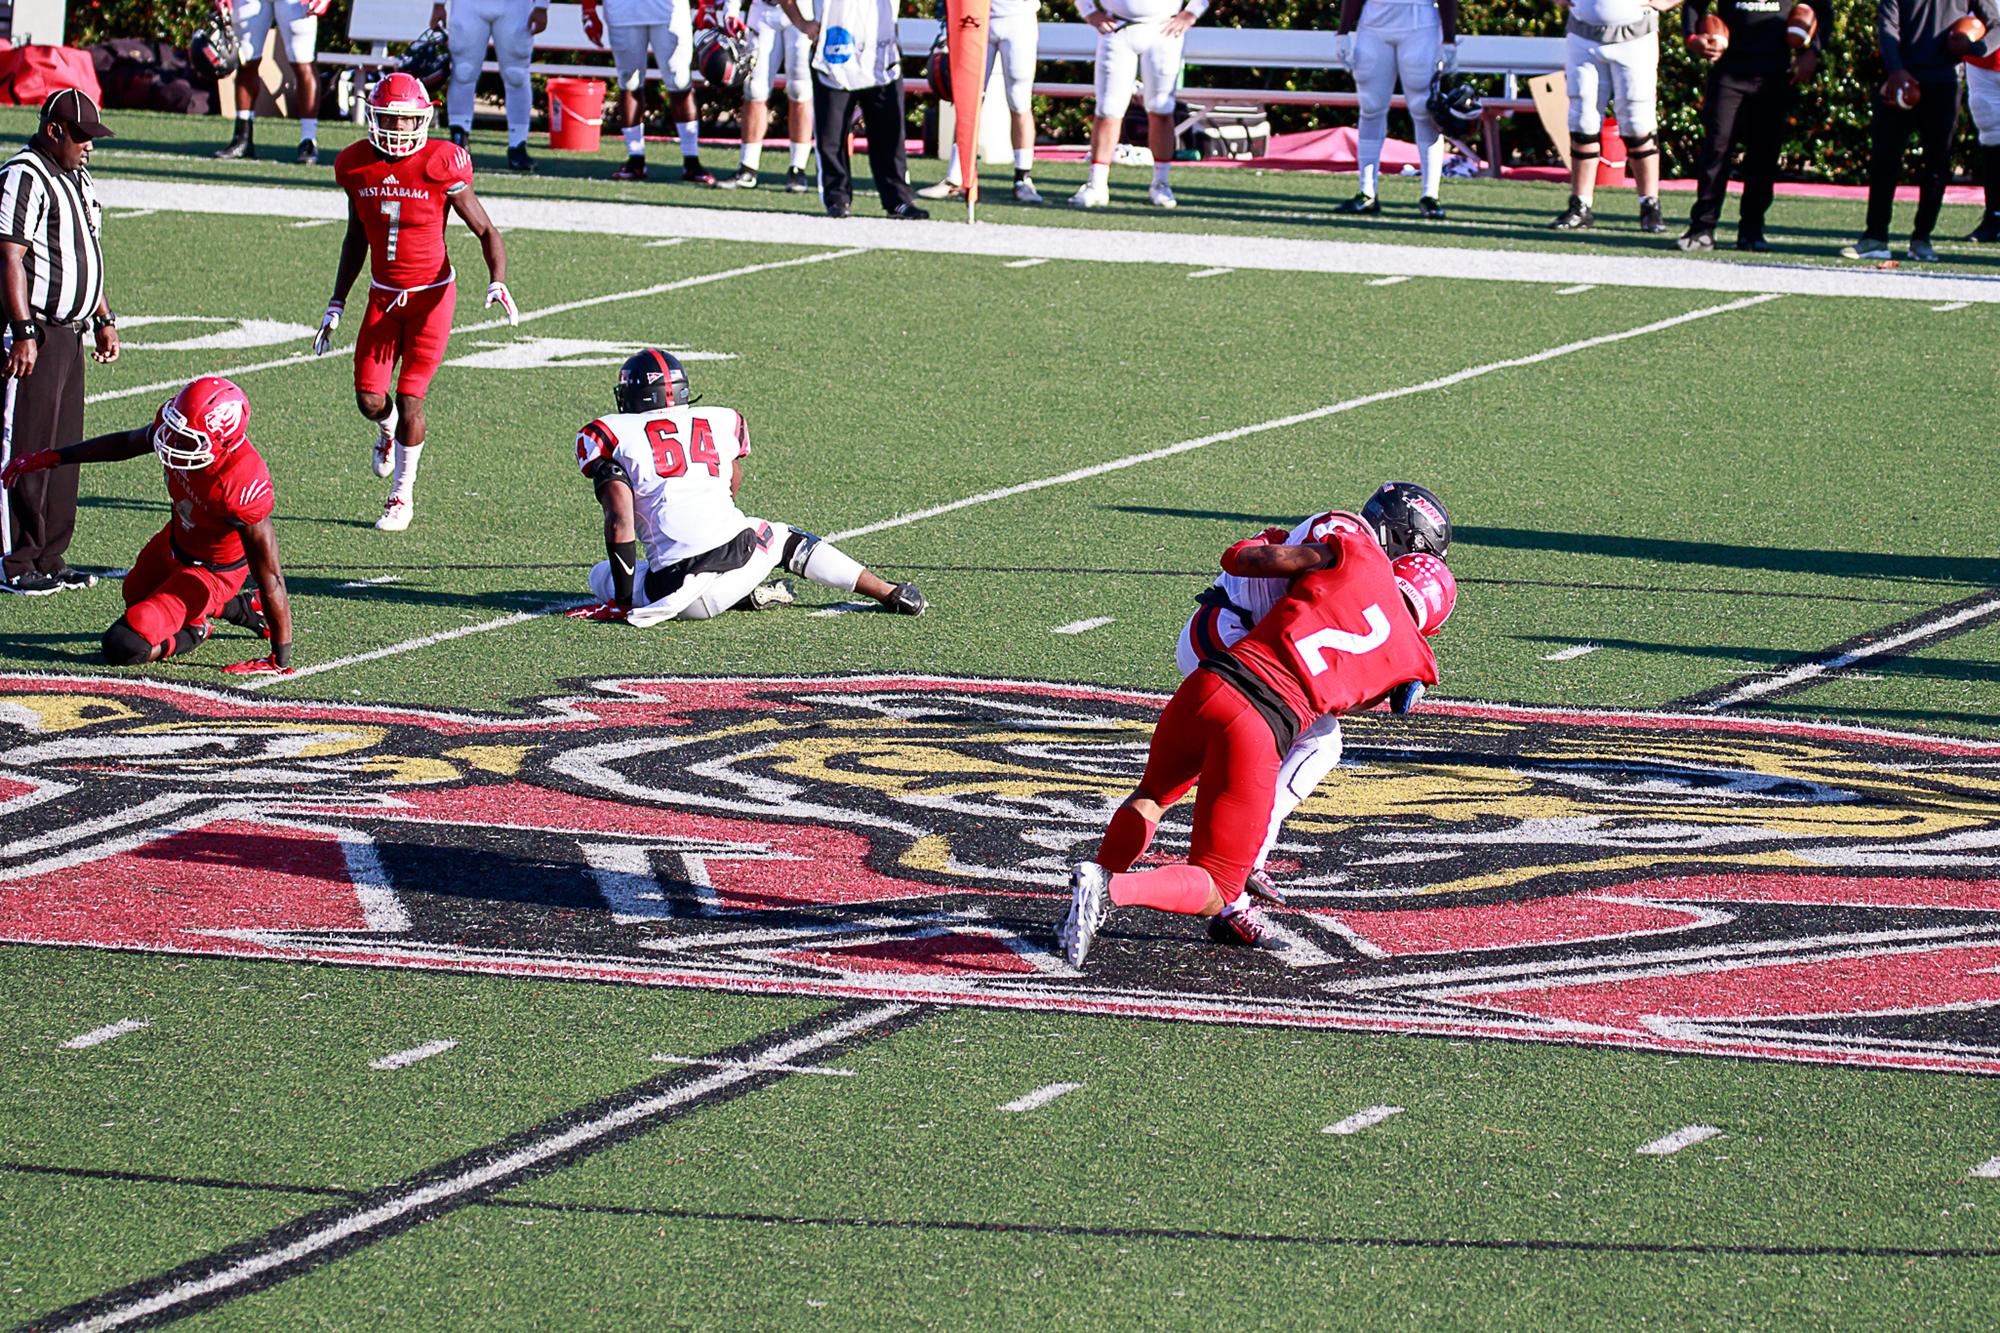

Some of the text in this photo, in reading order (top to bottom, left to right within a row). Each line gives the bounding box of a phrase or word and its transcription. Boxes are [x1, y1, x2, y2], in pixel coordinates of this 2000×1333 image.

[358, 186, 430, 200] WEST ALABAMA
[643, 417, 721, 478] 64
[1294, 602, 1391, 677] 2
